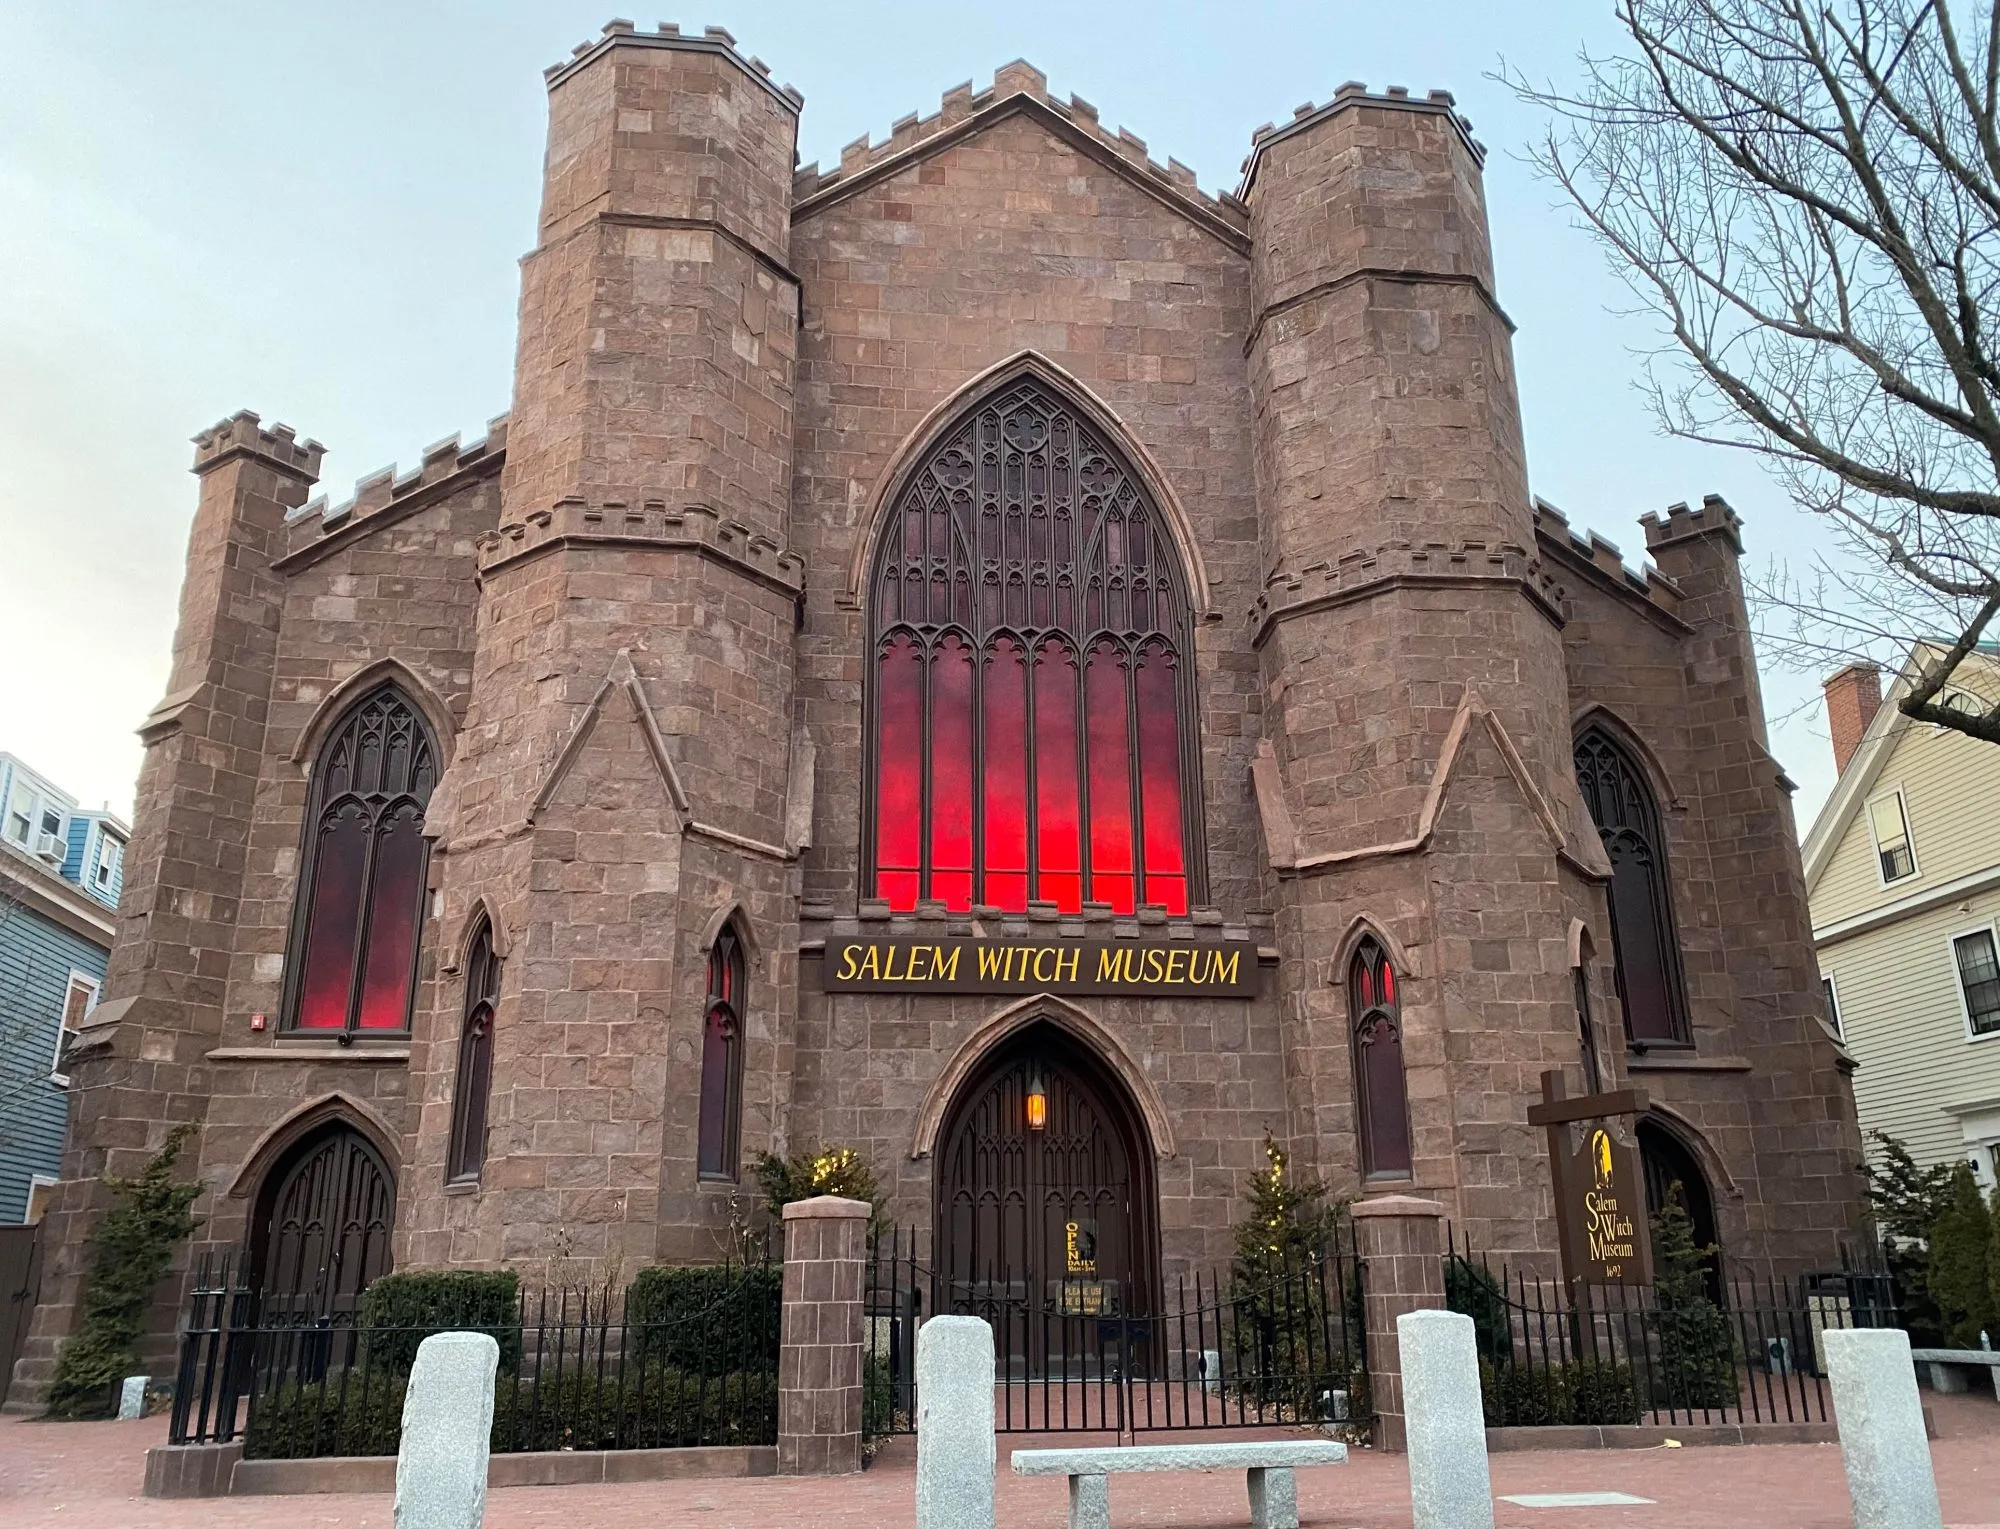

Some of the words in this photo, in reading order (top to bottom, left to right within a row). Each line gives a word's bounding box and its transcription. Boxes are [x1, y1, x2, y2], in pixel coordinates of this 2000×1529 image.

[836, 945, 962, 981] SALEM
[977, 947, 1080, 982] WITCH
[1096, 949, 1240, 985] MUSEUM
[1586, 1192, 1617, 1231] Salem
[1066, 1222, 1078, 1260] OPEN
[1600, 1214, 1633, 1241] Witch
[1589, 1232, 1633, 1260] Museum
[1606, 1265, 1621, 1277] 1692
[1065, 1287, 1088, 1295] PLEAE
